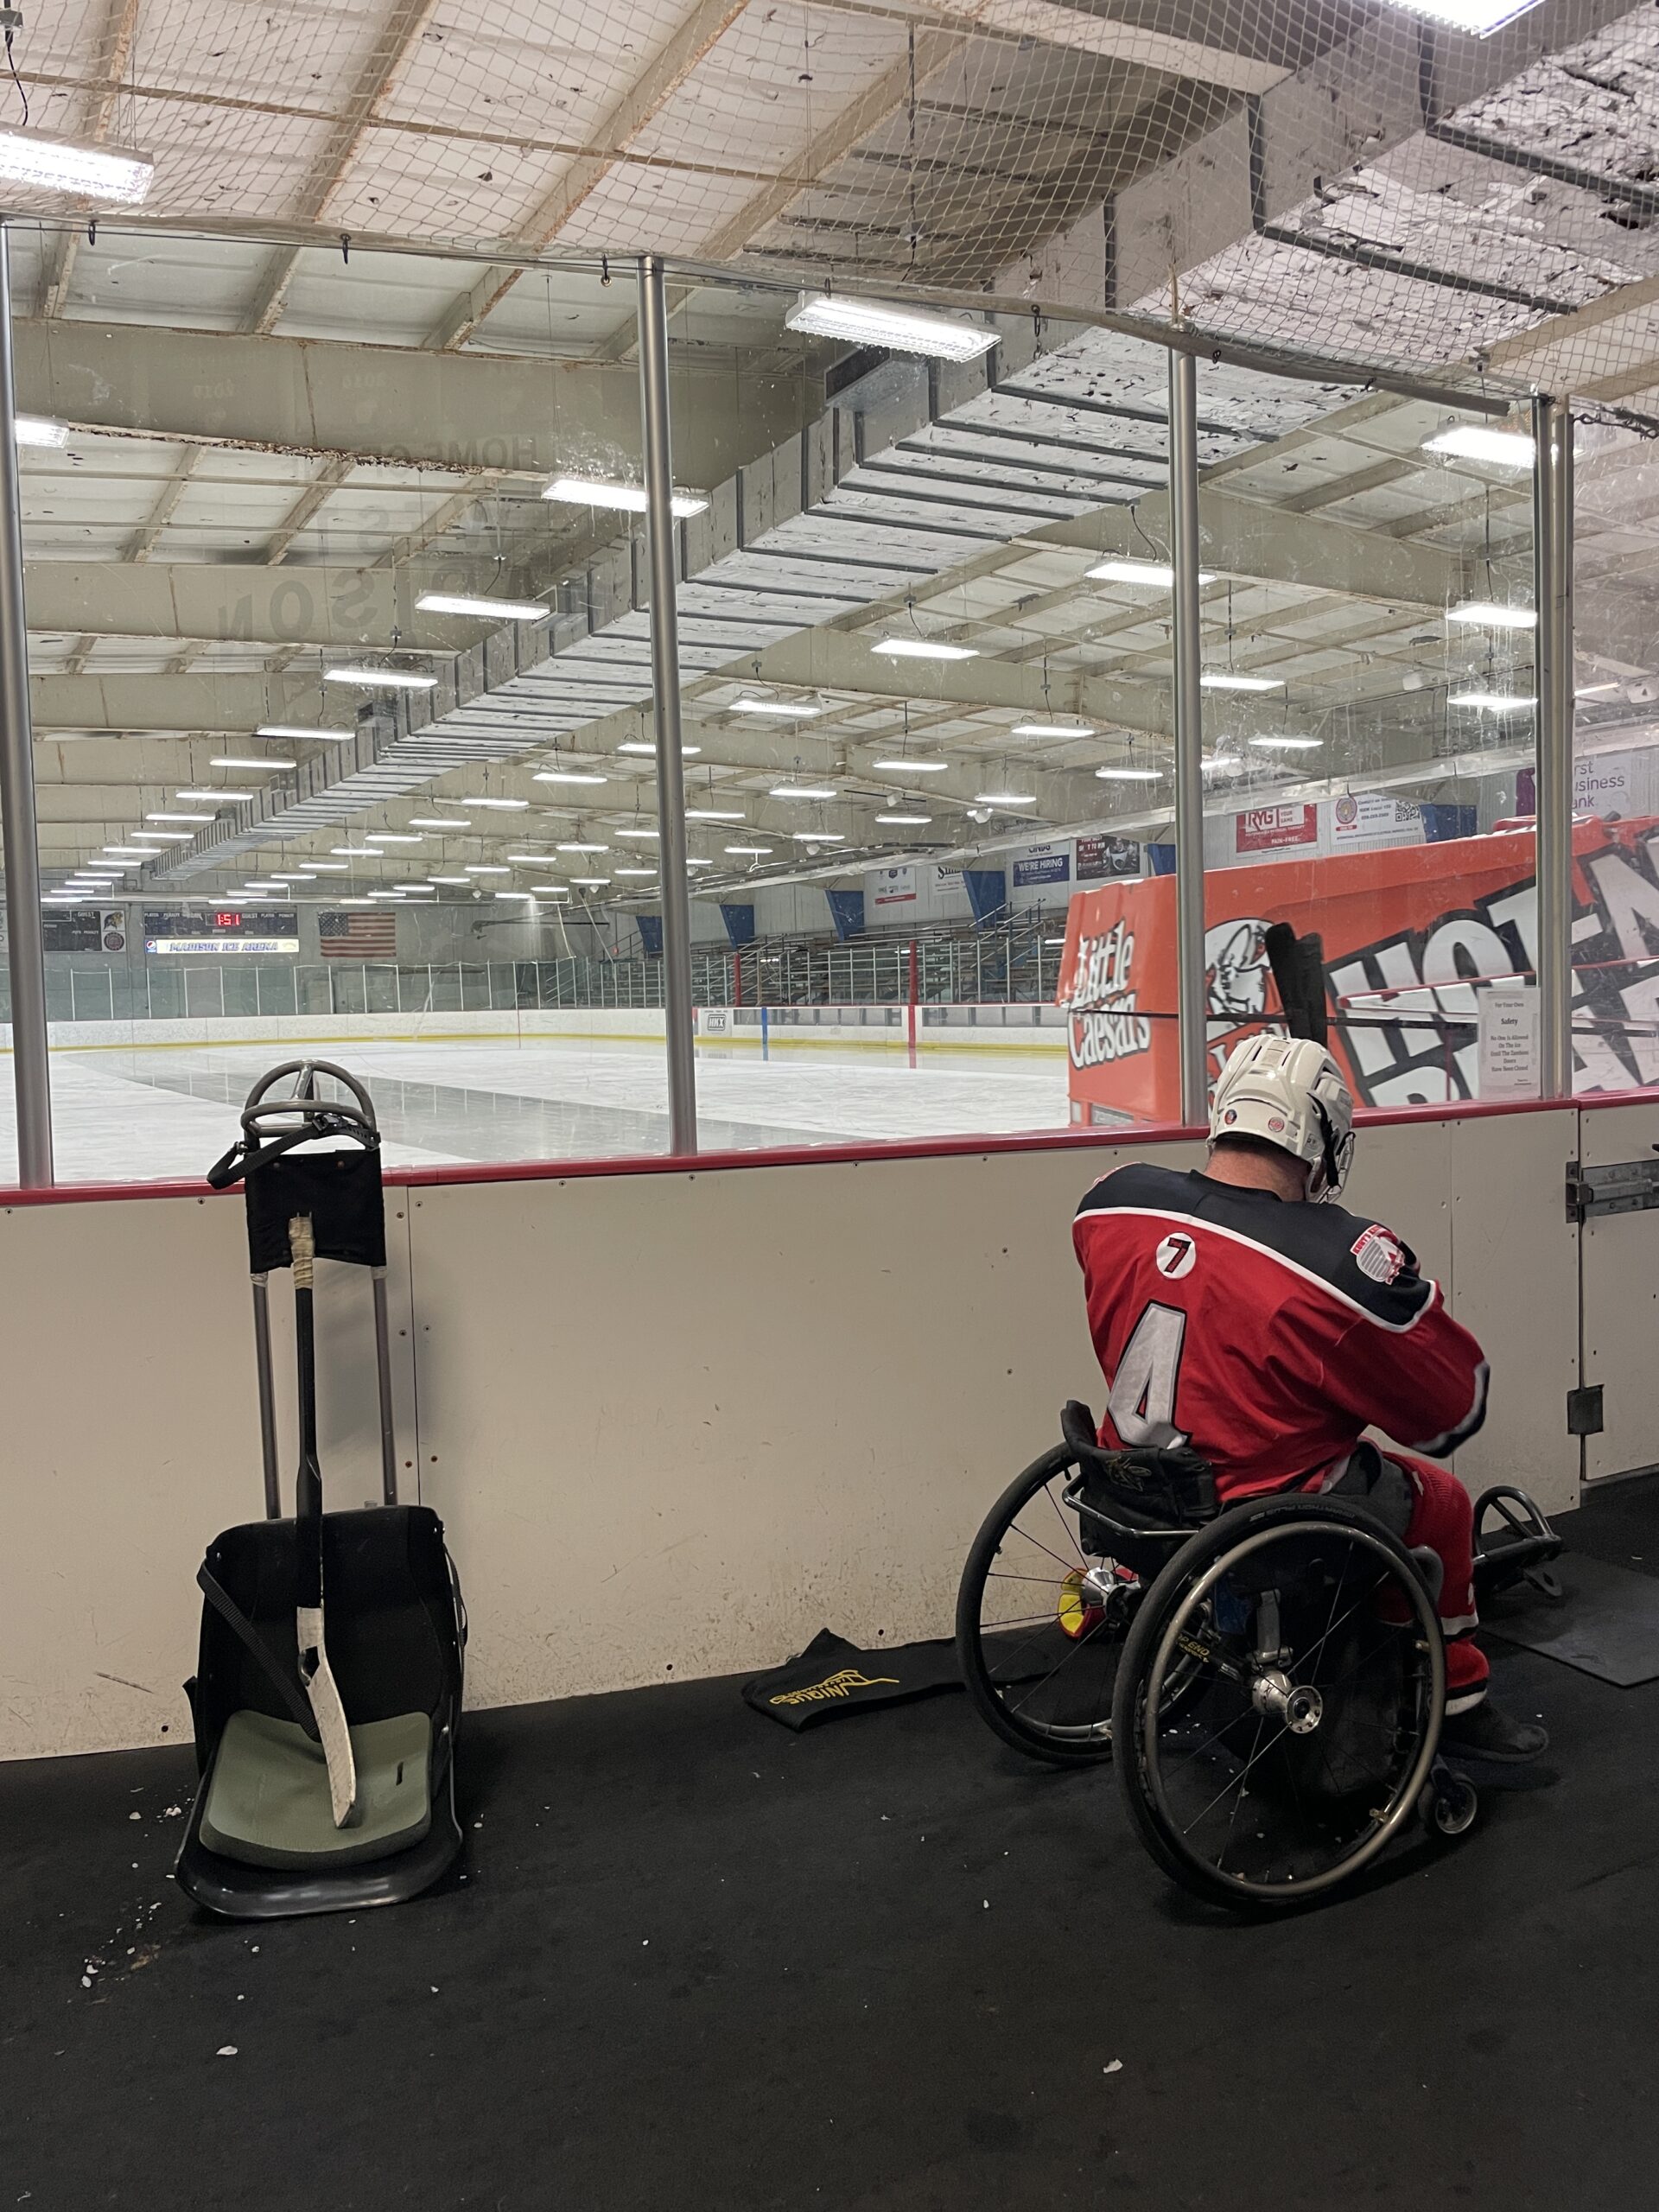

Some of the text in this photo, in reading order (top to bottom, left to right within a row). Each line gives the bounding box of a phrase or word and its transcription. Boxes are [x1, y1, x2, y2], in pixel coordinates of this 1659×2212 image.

[1574, 761, 1593, 775] rst
[1572, 795, 1594, 809] ank
[1039, 857, 1064, 869] HIRING
[169, 941, 219, 951] MADISON
[241, 941, 278, 951] ARENA
[1071, 918, 1134, 1009] Little
[1501, 1018, 1518, 1027] Safety
[1164, 1236, 1192, 1274] 7
[1107, 1299, 1192, 1450] 4
